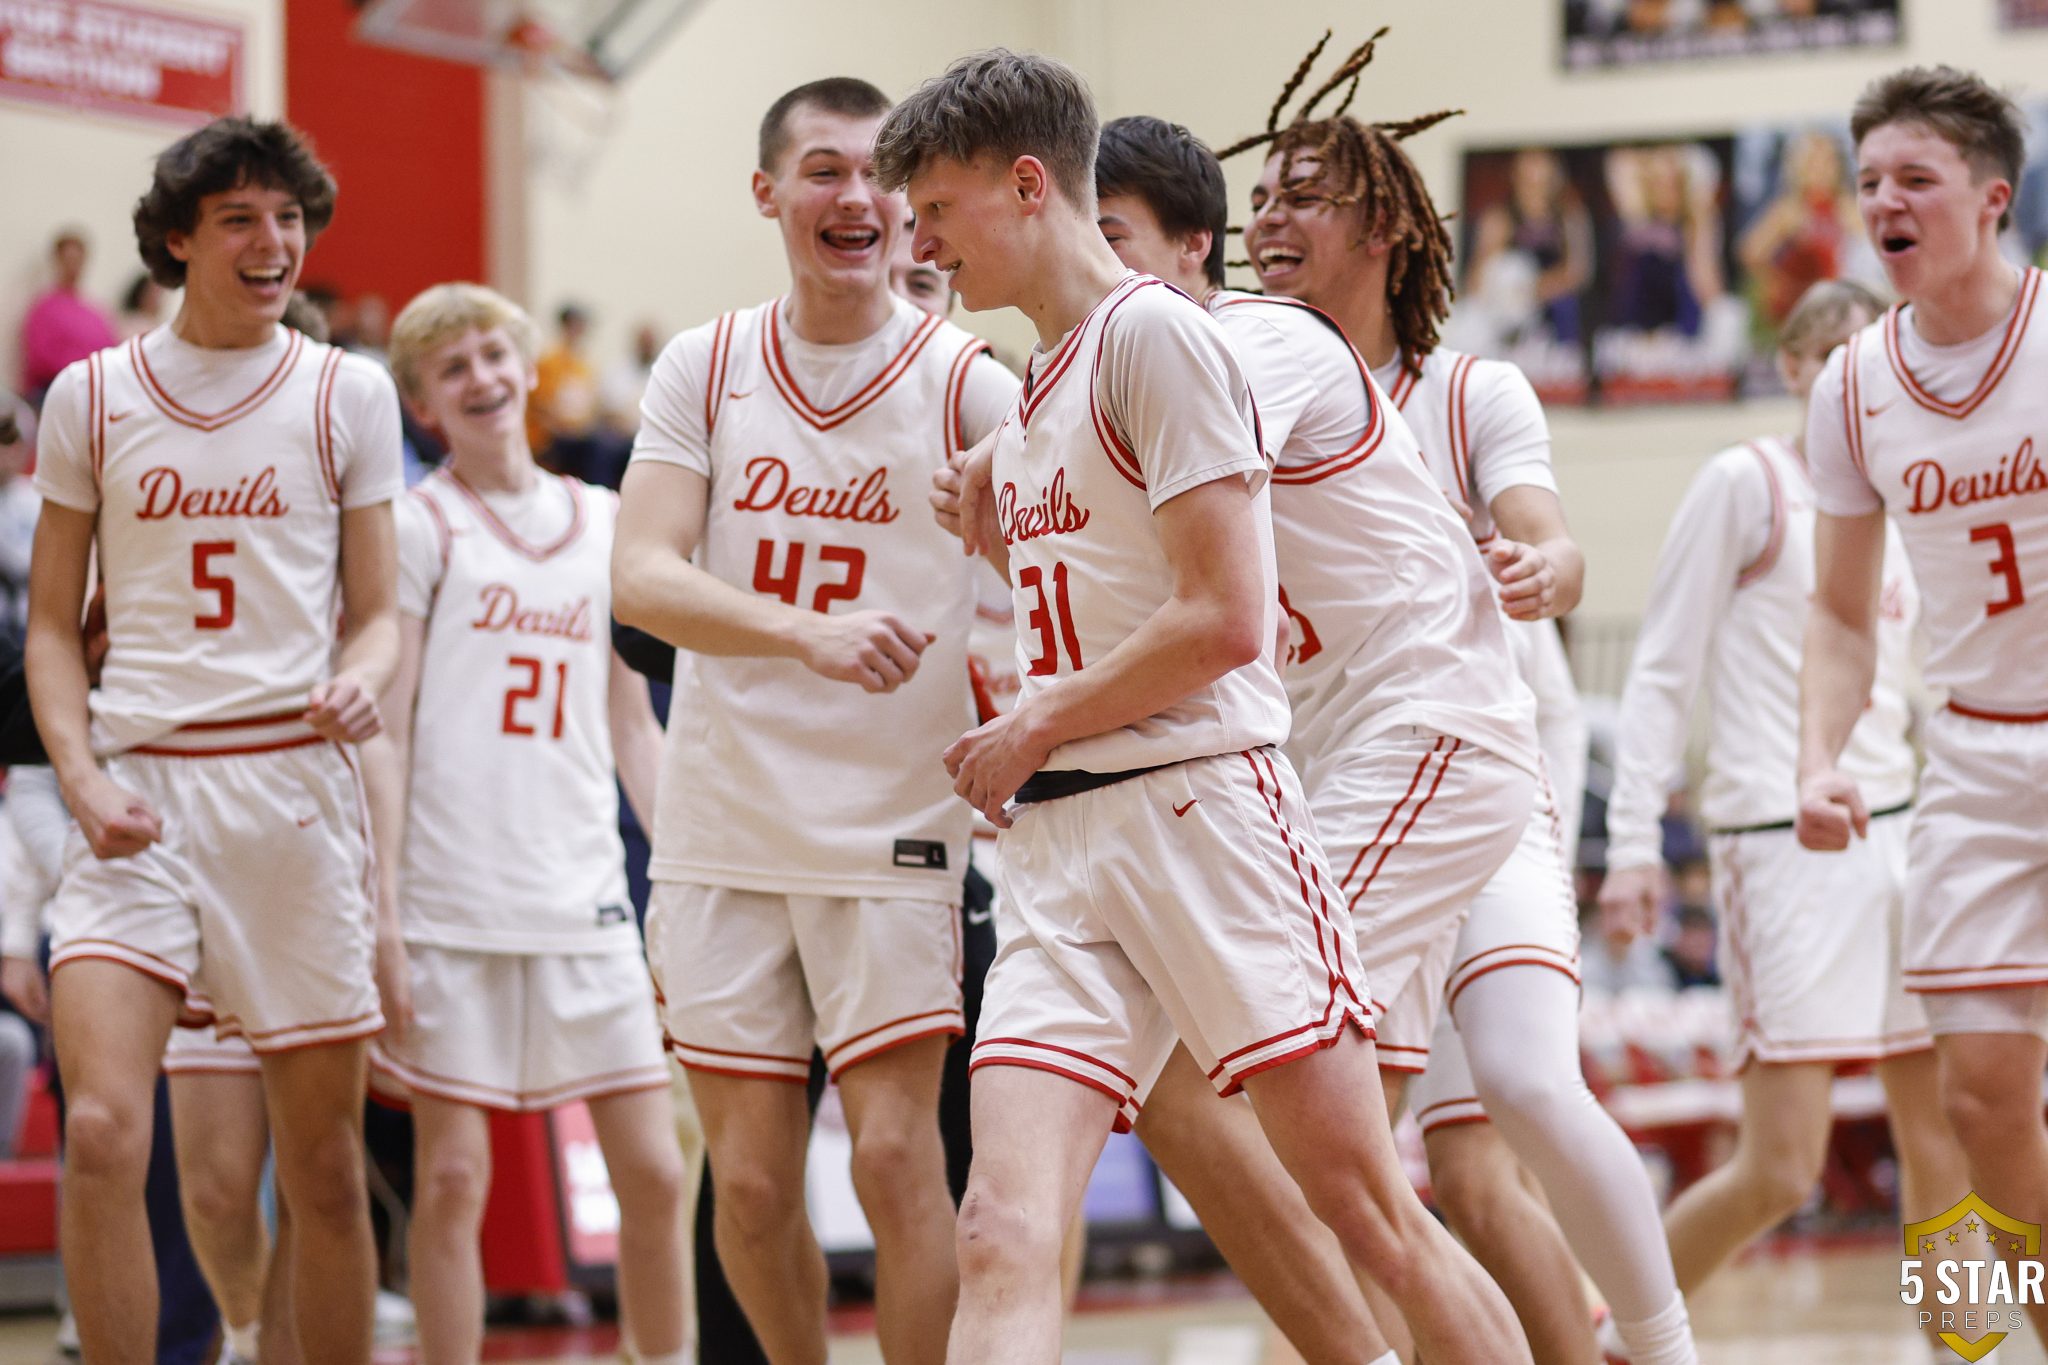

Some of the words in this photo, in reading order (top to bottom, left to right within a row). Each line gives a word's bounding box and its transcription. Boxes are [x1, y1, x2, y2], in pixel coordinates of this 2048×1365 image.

[135, 465, 289, 521] Devils
[734, 456, 900, 524] Devils
[998, 466, 1090, 546] Devils
[1903, 436, 2048, 515] Devils
[192, 540, 236, 630] 5
[752, 538, 866, 614] 42
[1970, 522, 2025, 617] 3
[471, 582, 594, 643] Devils
[1018, 561, 1084, 677] 31
[502, 656, 567, 739] 21
